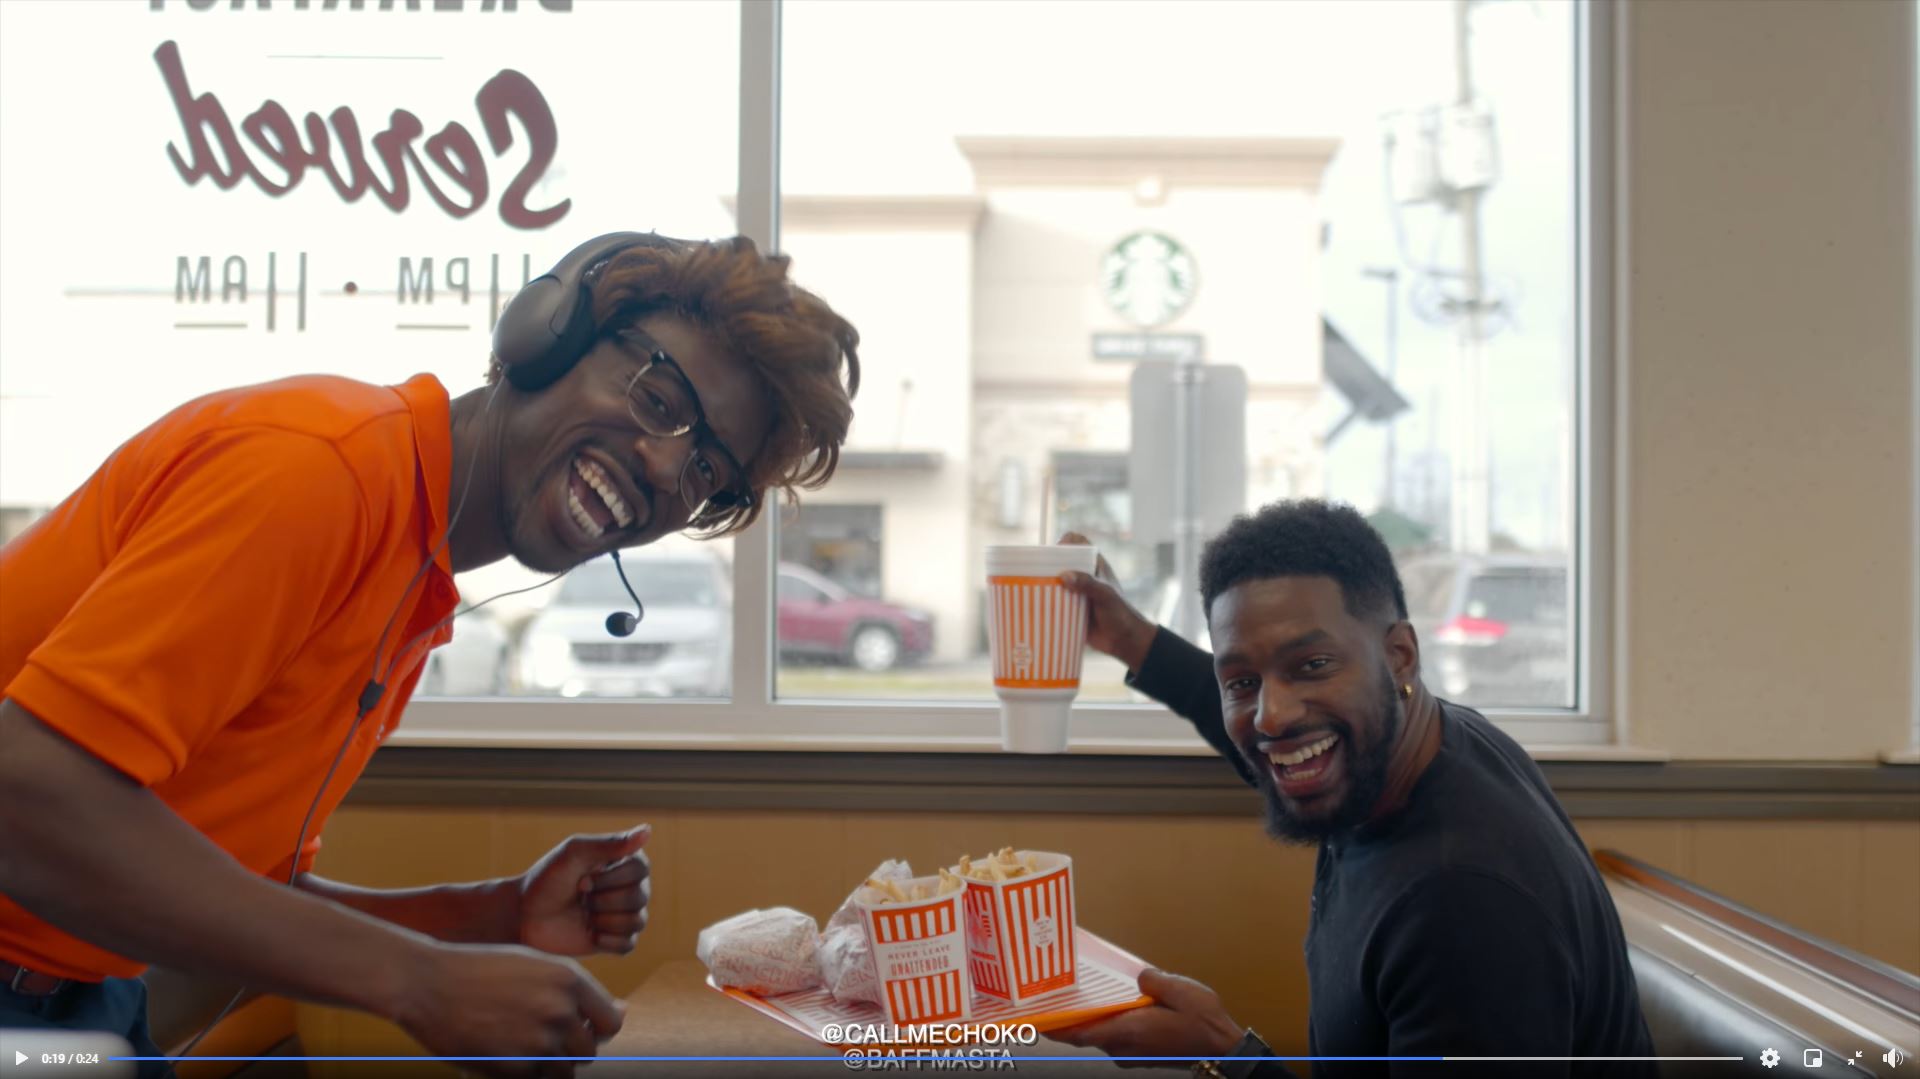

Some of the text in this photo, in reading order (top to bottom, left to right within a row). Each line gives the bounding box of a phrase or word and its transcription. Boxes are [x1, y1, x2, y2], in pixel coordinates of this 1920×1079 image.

[887, 944, 950, 960] NEVER LEAVE
[890, 955, 949, 976] UNATTENDED
